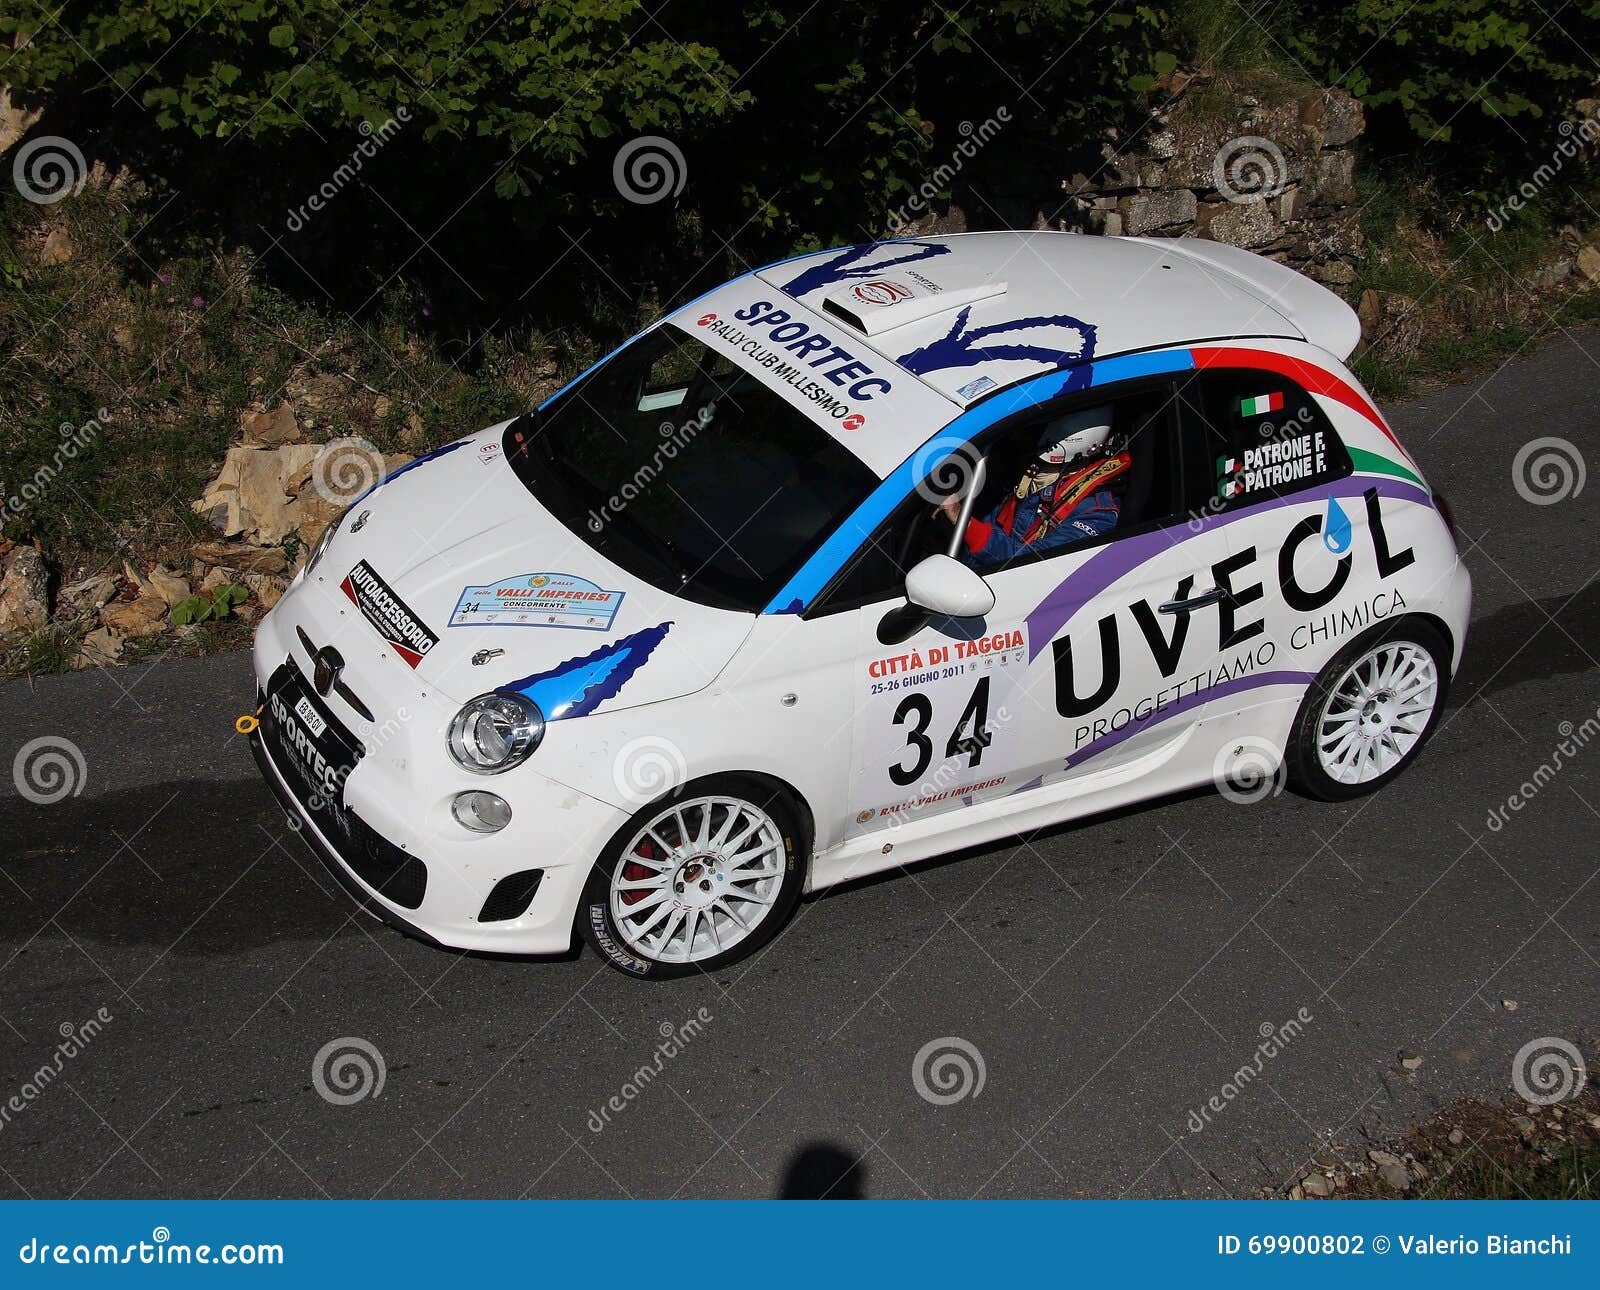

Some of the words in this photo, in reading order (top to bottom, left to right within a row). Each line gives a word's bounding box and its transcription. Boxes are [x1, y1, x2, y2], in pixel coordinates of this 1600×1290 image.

[734, 301, 892, 401] SPORTEC
[771, 361, 850, 420] MILLESIMO
[1244, 434, 1312, 471] PATRONE
[1314, 431, 1326, 453] F.
[1245, 455, 1313, 493] PATRONE
[1315, 452, 1327, 474] F.
[349, 564, 434, 654] AUTOACCESSORIO
[462, 602, 480, 614] 34
[496, 588, 533, 598] VALLI
[536, 590, 612, 602] IMPERIESI
[503, 601, 567, 609] CONCORRENTE
[1051, 486, 1416, 720] UVEOL
[868, 648, 924, 679] CITTÀ
[929, 649, 949, 665] DI
[954, 630, 1025, 658] TAGGIA
[871, 680, 900, 695] 25-26
[902, 671, 940, 688] GIUGNO
[942, 664, 965, 679] 2011
[1074, 641, 1276, 750] PROGETTIAMO
[1290, 588, 1407, 651] CHIMICA
[271, 693, 336, 792] SPORTEC
[888, 675, 993, 787] 34
[879, 800, 915, 817] RALLY
[919, 792, 949, 806] VALLI
[950, 776, 1007, 798] IMPERIESI
[590, 906, 634, 966] MICHELIN
